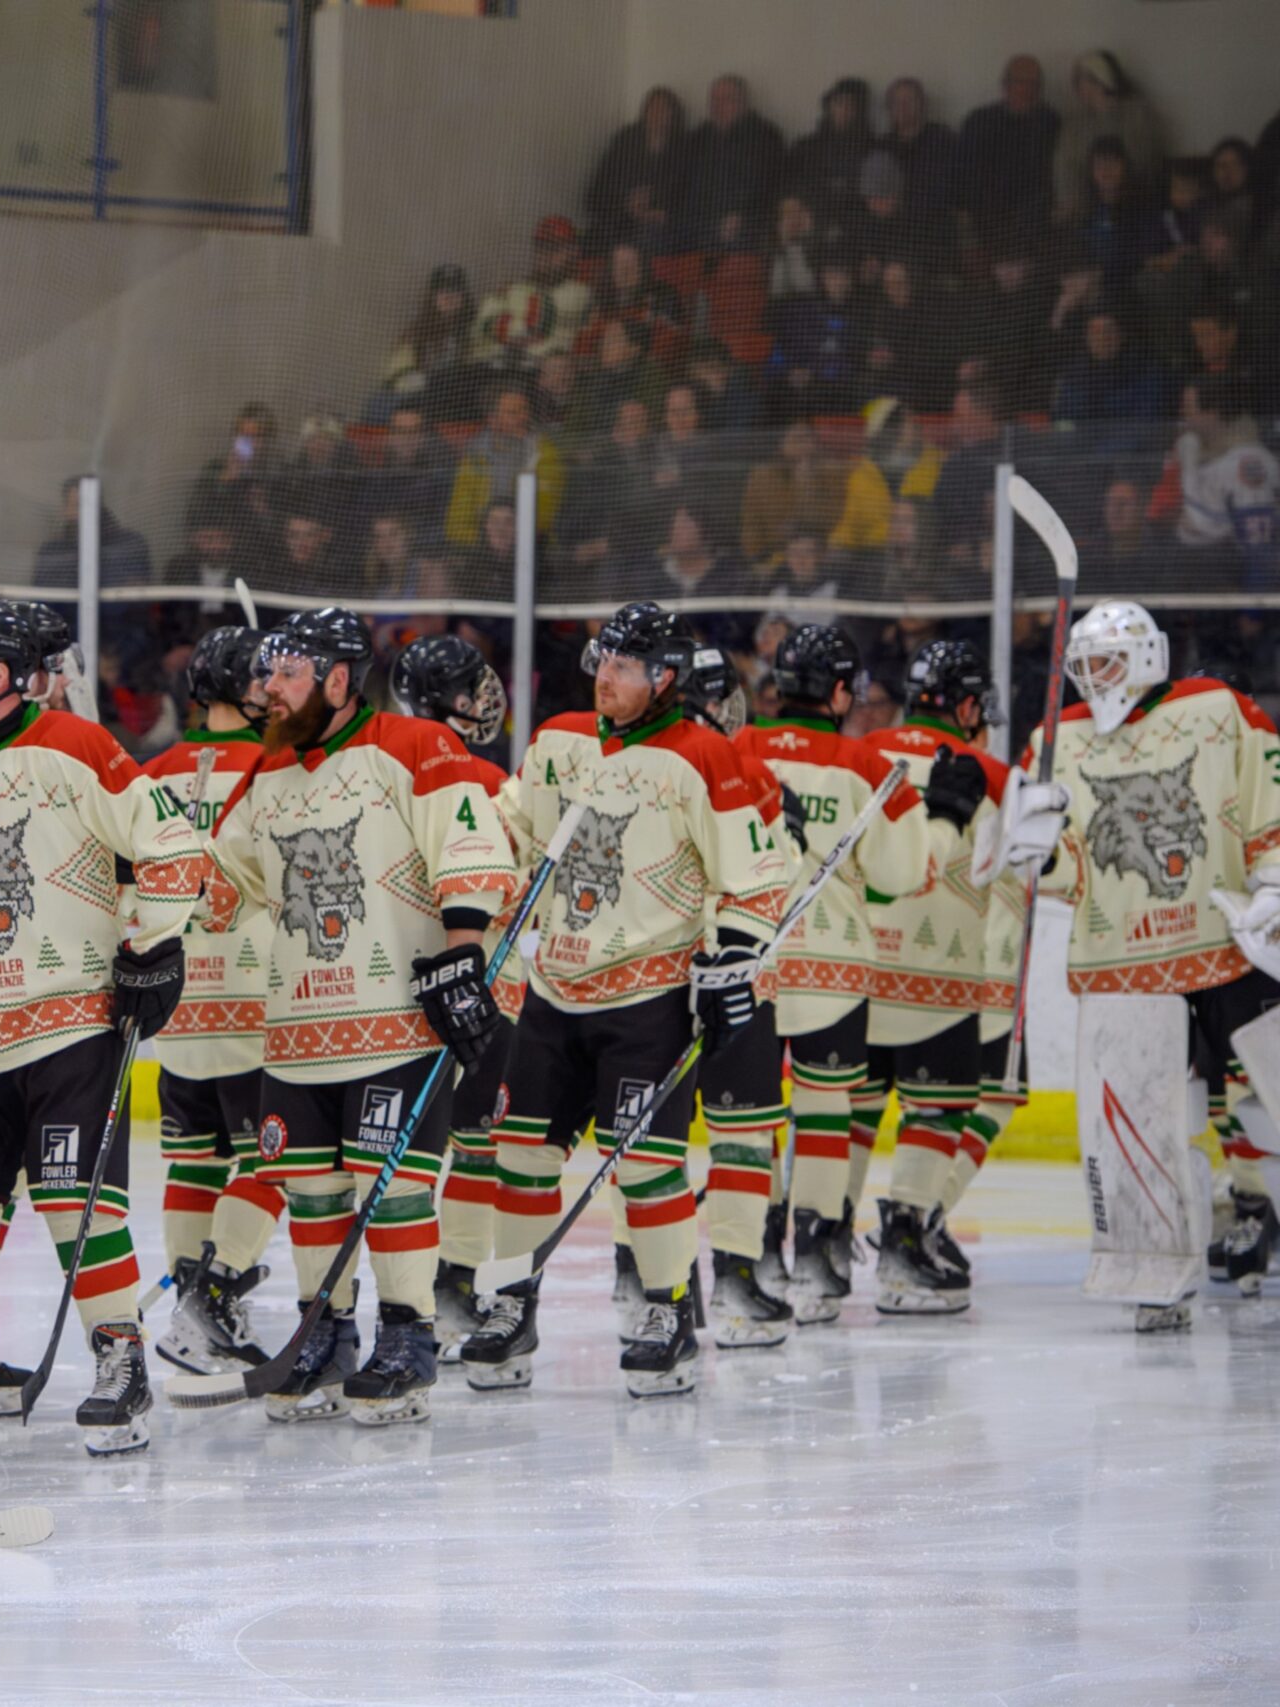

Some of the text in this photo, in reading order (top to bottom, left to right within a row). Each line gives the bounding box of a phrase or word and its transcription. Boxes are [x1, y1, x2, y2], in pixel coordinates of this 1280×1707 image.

[545, 758, 559, 786] A
[456, 796, 477, 831] 4
[312, 966, 355, 984] FOWLER
[410, 957, 475, 998] AUER
[357, 1126, 398, 1143] FOWLER
[41, 1164, 78, 1179] FOWLER
[1087, 1156, 1109, 1234] BAUER
